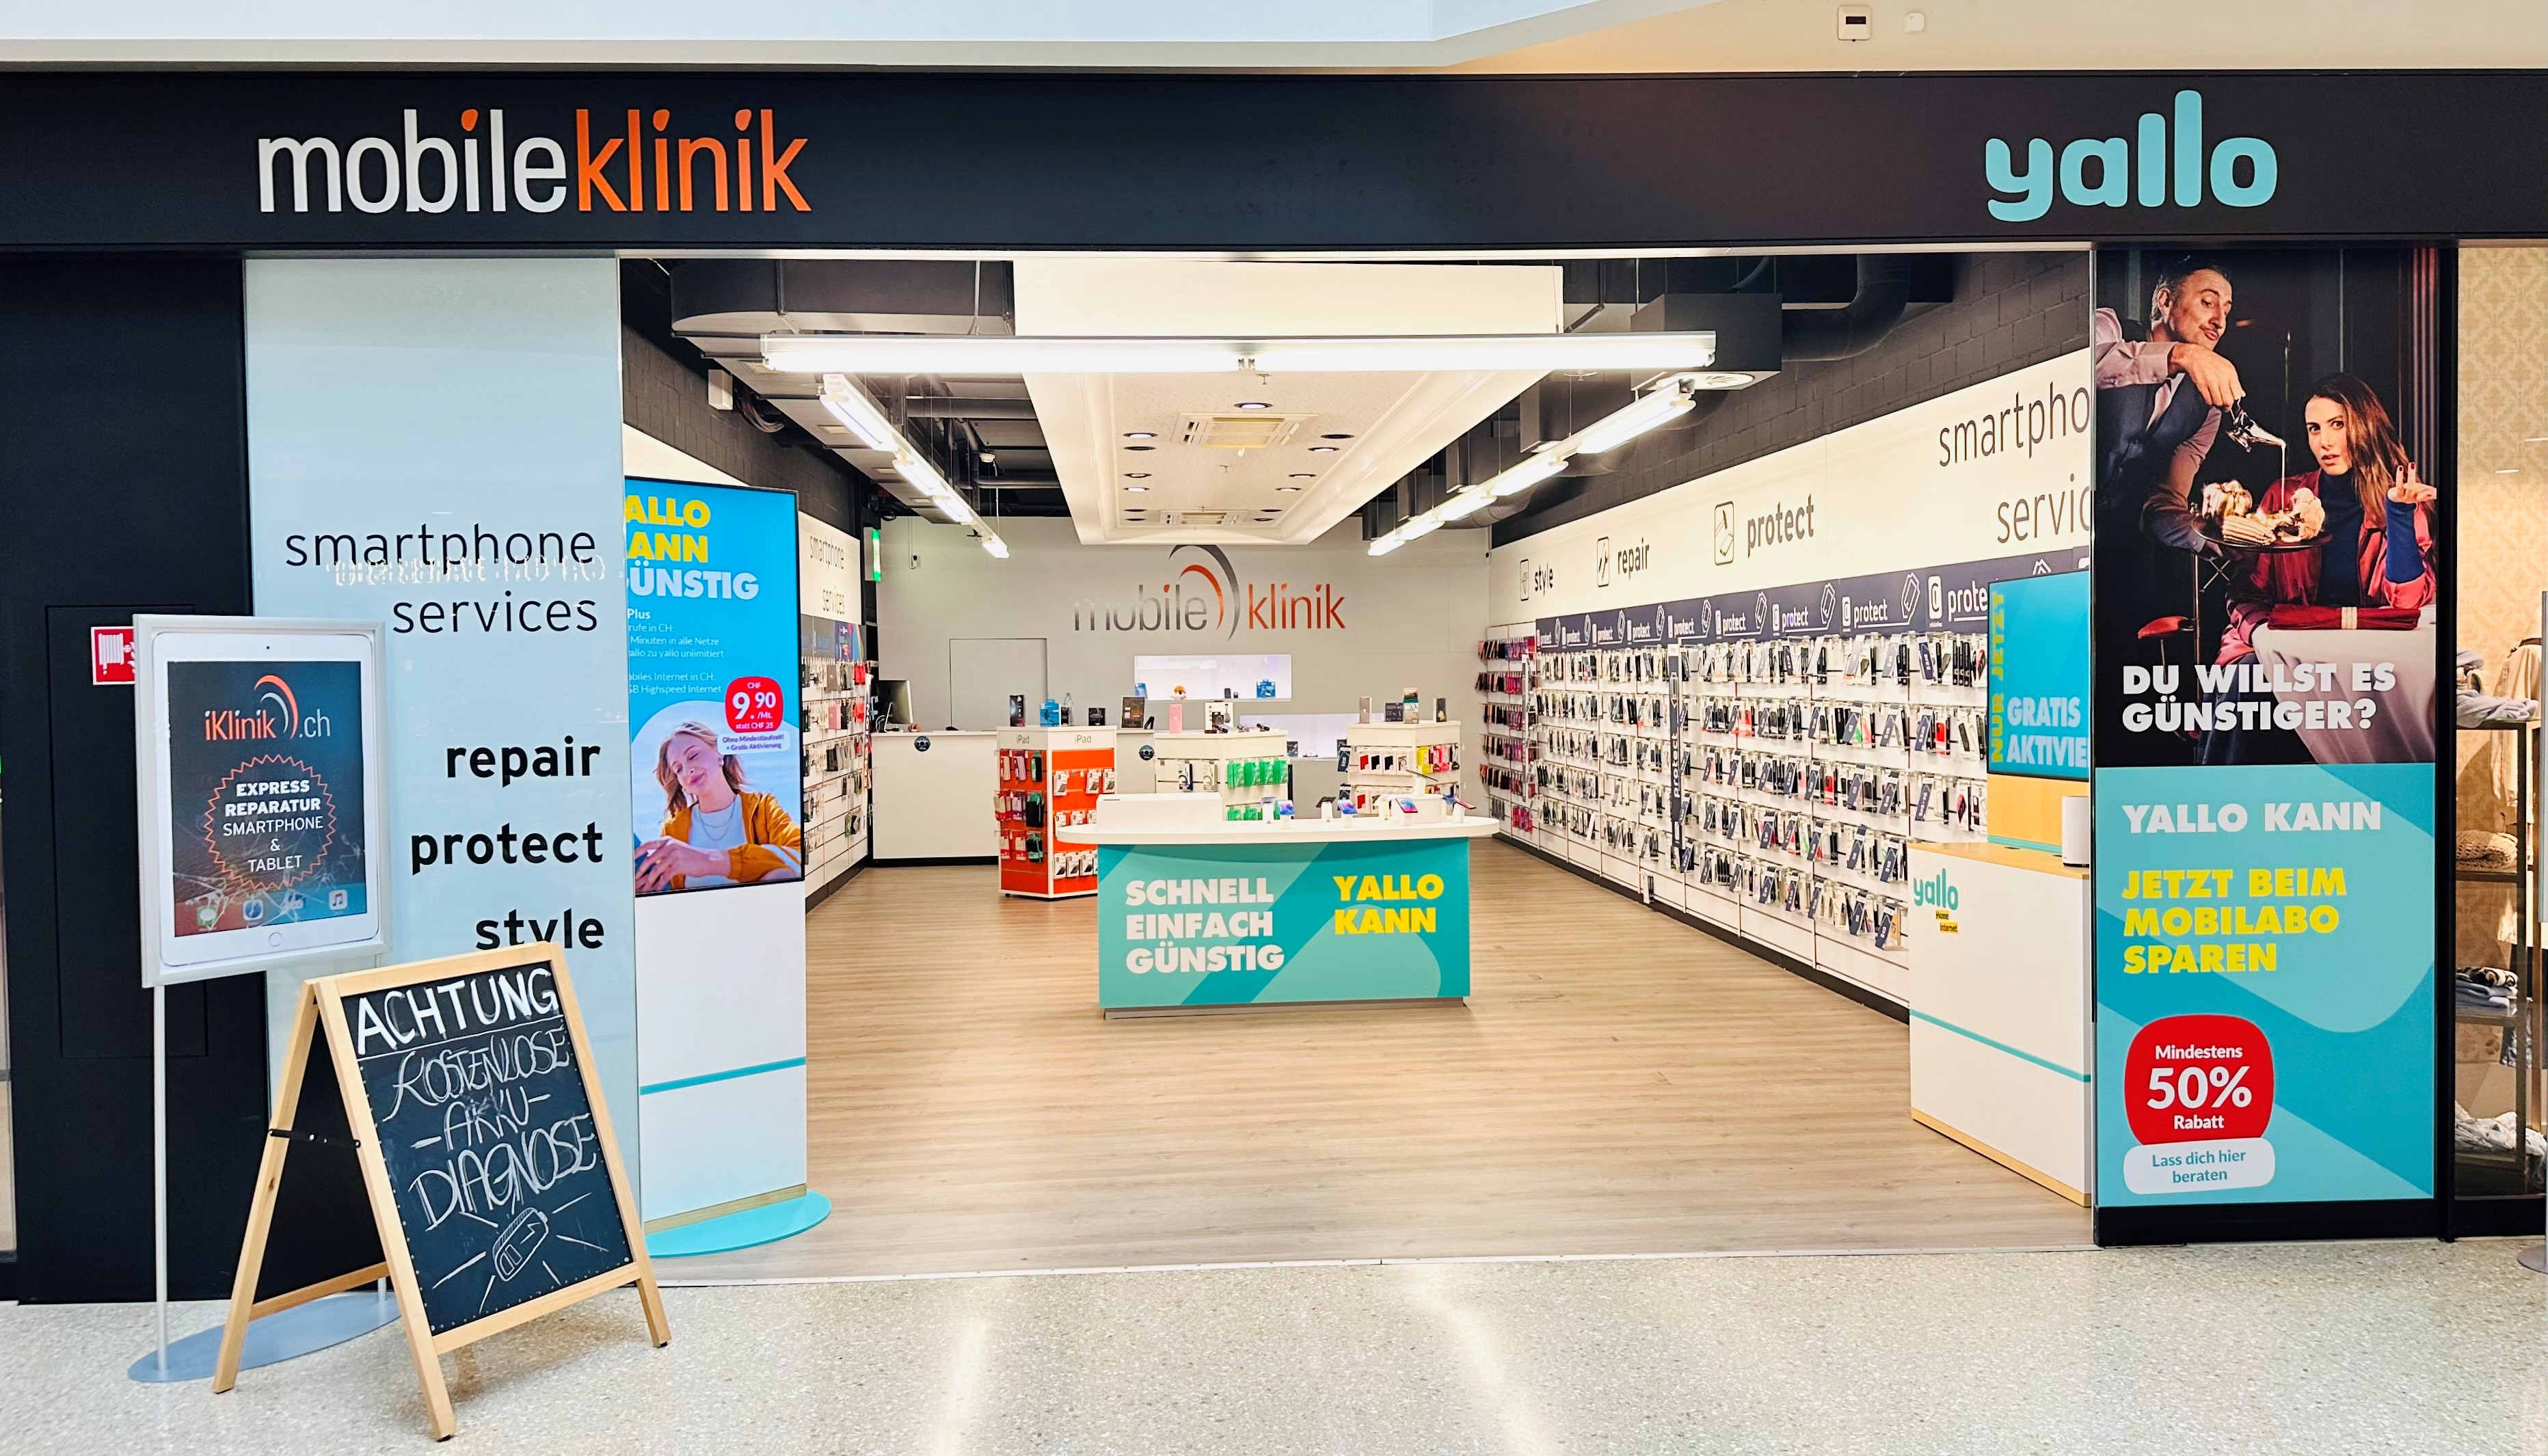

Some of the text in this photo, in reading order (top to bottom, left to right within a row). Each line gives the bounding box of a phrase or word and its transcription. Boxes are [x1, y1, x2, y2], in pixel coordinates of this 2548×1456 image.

[1985, 90, 2277, 221] yallo
[1940, 381, 2089, 467] smartpho
[626, 495, 711, 528] ALLO
[1747, 493, 1814, 559] protect
[285, 523, 596, 575] smartphone
[627, 531, 708, 563] ANN
[810, 535, 844, 571] smartphone
[1618, 537, 1650, 580] repair
[627, 559, 760, 599] ÜNSTIG
[1534, 563, 1553, 597] style
[392, 591, 598, 634] services
[627, 608, 651, 619] Plus
[822, 585, 844, 615] services
[1074, 583, 1346, 631] mobile klinik
[1853, 599, 1888, 628] protect
[1948, 580, 1987, 623] prote
[629, 623, 675, 632] rufe in CH:
[1633, 621, 1650, 640] protect
[1674, 617, 1695, 638] protect
[1723, 612, 1746, 636] protect
[1782, 606, 1808, 632] protect
[629, 648, 645, 657] allo
[659, 649, 680, 658] yallo
[630, 636, 719, 645] Minuten in alle Netze
[641, 685, 686, 695] Highspeed
[688, 685, 722, 693] Internet
[654, 673, 689, 681] Internet
[690, 672, 698, 681] in
[699, 672, 716, 681] CH:
[1992, 591, 2004, 763] NUR JETZT
[2123, 662, 2396, 695] DU WILLST ES
[2007, 696, 2080, 728] GRATIS
[2122, 695, 2377, 732] GÜNSTIGER?
[1016, 735, 1030, 744] iPad
[1074, 734, 1092, 744] iPad
[2007, 734, 2089, 768] AKTIVIE
[447, 736, 601, 787] repair
[1672, 732, 1680, 798] protect
[236, 779, 310, 798] EXPRESS
[225, 797, 321, 818] REPARATUR
[2122, 802, 2382, 833] YALLO KANN
[223, 815, 324, 837] SMARTPHONE
[270, 838, 281, 851] &
[412, 822, 603, 875] protect
[247, 854, 303, 873] TABLET
[1125, 877, 1274, 906] SCHNELL
[1333, 874, 1445, 901] YALLO
[1914, 867, 1959, 911] yallo
[2122, 867, 2347, 899] JETZT BEIM
[476, 908, 604, 951] style
[1126, 911, 1273, 940] EINFACH
[1335, 907, 1436, 934] KANN
[2123, 905, 2339, 936] MOBILABO
[1126, 941, 1285, 974] GÜNSTIG
[2123, 943, 2277, 974] SPAREN
[357, 968, 559, 1055] ACHTUNG
[2155, 1044, 2242, 1060] Mindestens
[382, 1025, 570, 1122] KOSTENLOSE
[2147, 1066, 2253, 1109] 50%
[2173, 1114, 2225, 1130] Rabatt
[408, 1113, 597, 1231] DIAGNOSE
[2152, 1148, 2247, 1168] Lass dich hier
[2173, 1169, 2228, 1185] beraten
